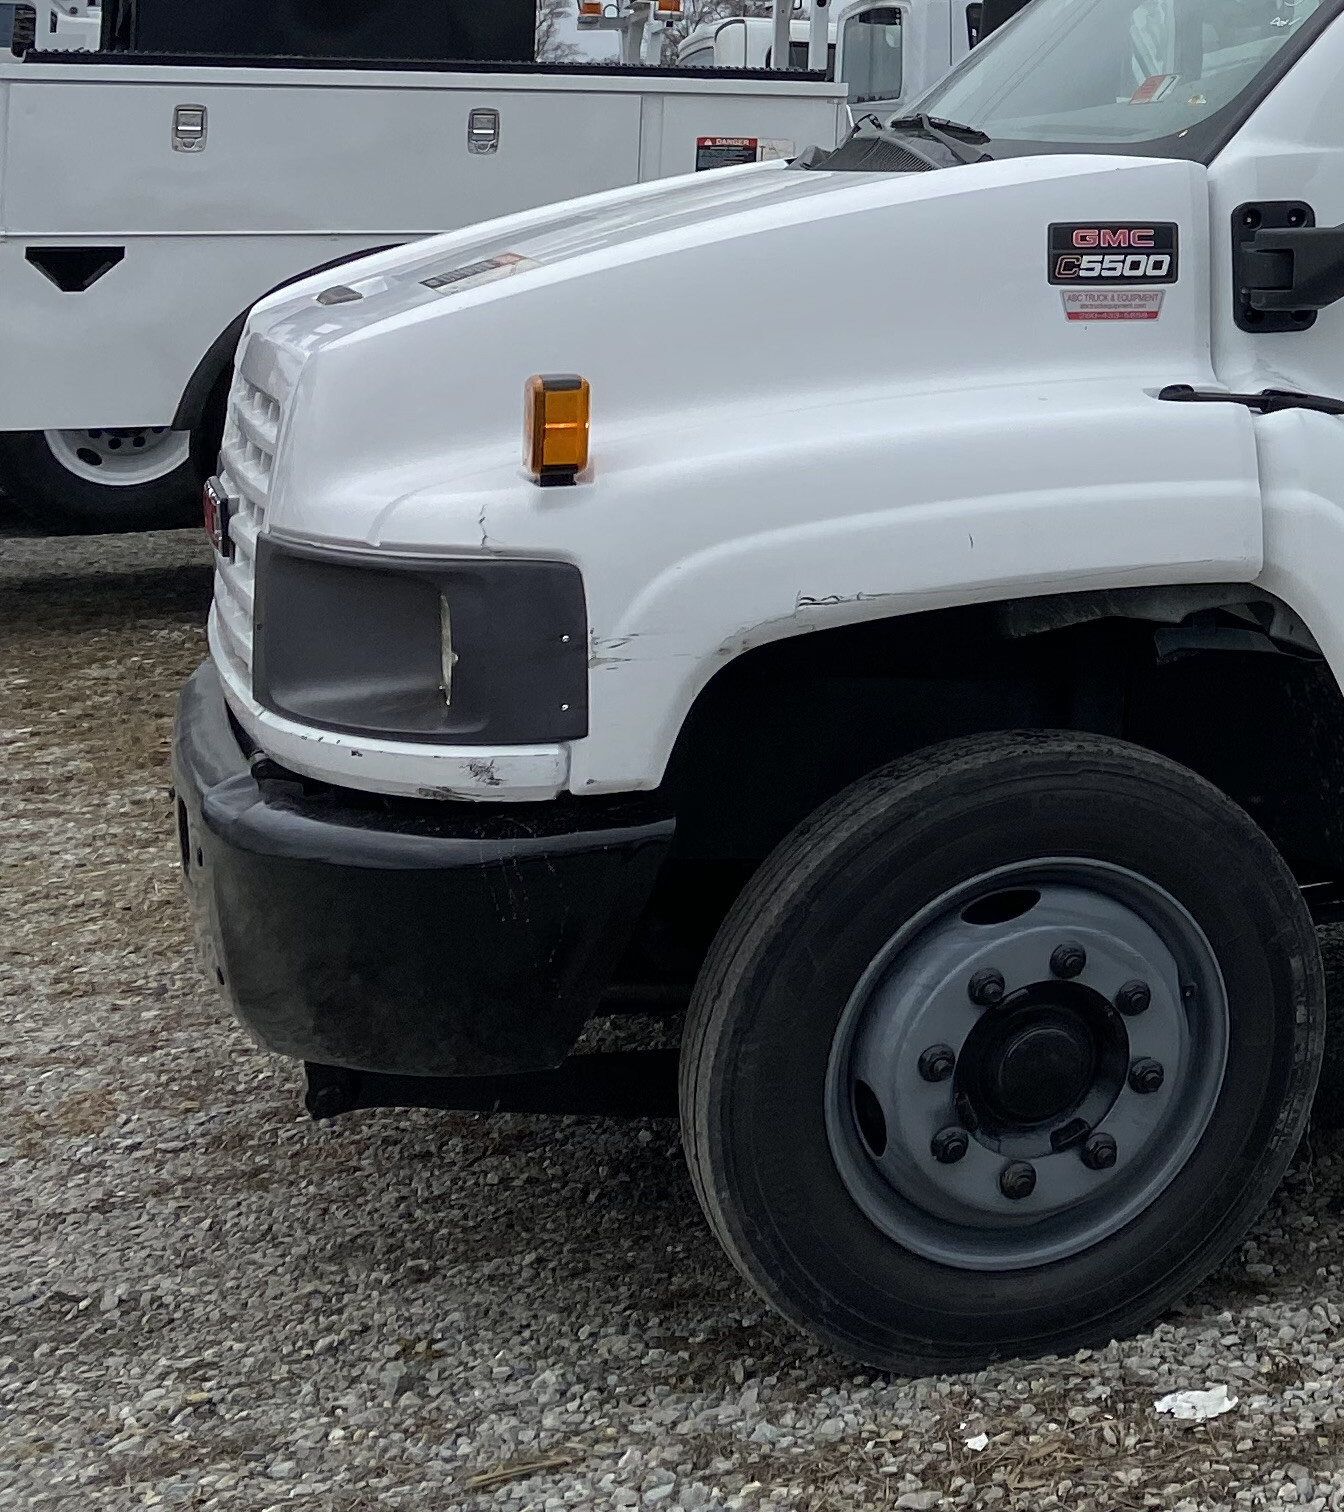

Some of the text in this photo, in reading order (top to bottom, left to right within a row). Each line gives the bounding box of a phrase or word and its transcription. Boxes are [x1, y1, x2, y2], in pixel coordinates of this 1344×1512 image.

[1073, 229, 1155, 247] GMC
[1055, 254, 1171, 278] C5500
[1085, 294, 1109, 302] TRUCK
[1117, 293, 1159, 302] EQUIPMENT
